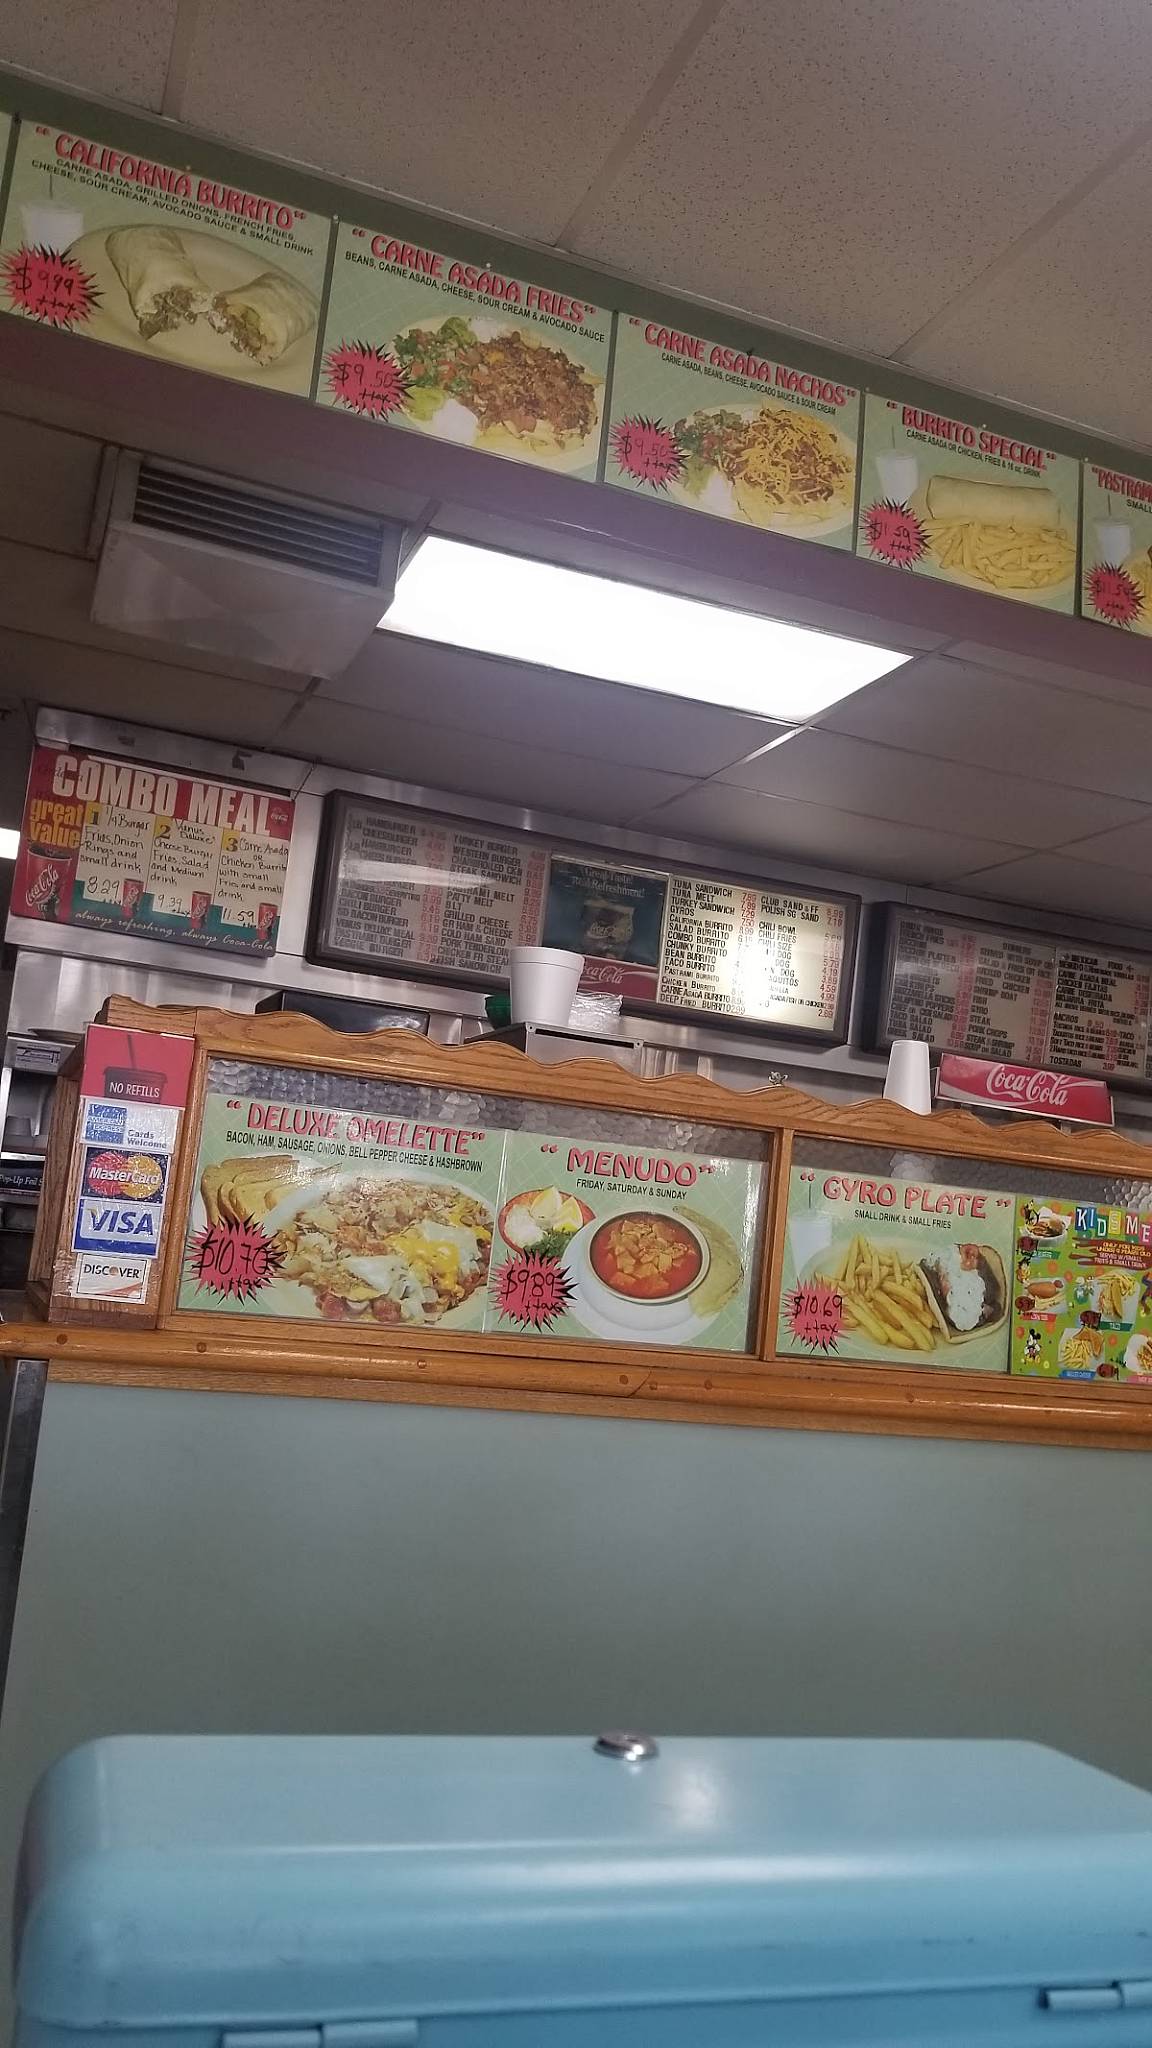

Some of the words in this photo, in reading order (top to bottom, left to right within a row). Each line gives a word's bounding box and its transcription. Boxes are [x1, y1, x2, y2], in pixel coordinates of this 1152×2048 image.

[57, 159, 91, 178] CARNE
[136, 184, 180, 204] GRILLED
[81, 174, 109, 192] SOUR
[152, 198, 202, 220] AVOCADO
[204, 215, 237, 232] SAUCE
[249, 229, 281, 247] SMALL
[284, 240, 313, 256] DRINK
[371, 234, 446, 279] CARNE
[448, 261, 521, 306] ASADA
[379, 261, 408, 278] CARNE
[478, 294, 500, 308] SOUR
[502, 303, 531, 319] CREAM
[539, 315, 577, 333] AVOCADO
[579, 327, 605, 343] SAUCE
[644, 322, 706, 364] CARNE
[709, 344, 770, 385] ASADA
[661, 352, 681, 367] CARNE
[749, 382, 775, 397] AVOCADO
[817, 403, 837, 416] CREAM
[901, 405, 976, 448] BURRITO
[928, 436, 948, 450] ASADA
[53, 754, 180, 814] COMBO
[187, 780, 272, 836] MEAL
[30, 799, 83, 827] great
[30, 820, 81, 849] value
[226, 837, 239, 852] 3
[117, 850, 138, 859] and
[151, 863, 167, 873] and
[494, 890, 515, 903] MELT
[674, 880, 692, 891] TUNA
[695, 884, 733, 898] SANDWICH
[696, 892, 715, 903] MELT
[446, 891, 470, 904] PATTY
[473, 896, 494, 908] MELT
[671, 896, 697, 909] TURKEY
[699, 902, 735, 916] SANDWICH
[760, 895, 780, 907] CLUB
[783, 899, 803, 911] SAND
[444, 908, 475, 923] GRILLED
[479, 915, 510, 929] CHEESE
[670, 905, 695, 917] GYROS
[760, 904, 785, 917] POLISH
[786, 910, 797, 919] SG
[800, 912, 820, 923] SAND
[75, 910, 113, 927] always
[181, 928, 218, 945] always
[483, 925, 512, 940] CHEESE
[669, 922, 693, 934] SALAD
[697, 927, 730, 941] BURRITO
[704, 920, 733, 932] BURRITO
[758, 921, 776, 932] CHILI
[441, 928, 461, 938] COLD
[463, 931, 482, 943] HAM
[485, 935, 506, 948] SAND
[441, 936, 461, 948] PORK
[667, 931, 693, 943] COMBO
[696, 936, 726, 949] BURRITO
[777, 934, 797, 945] FRIES
[777, 941, 792, 952] SIZE
[665, 949, 685, 960] BEAN
[686, 952, 717, 964] BURRITO
[666, 939, 694, 951] CHUNKY
[696, 945, 728, 958] BURRITO
[777, 951, 792, 961] DOG
[665, 957, 685, 968] TACO
[686, 961, 715, 973] BURRITO
[780, 969, 795, 979] DOG
[1049, 1055, 1083, 1068] TOSTADAS
[109, 1081, 124, 1094] NO
[126, 1083, 160, 1099] REFILLS
[986, 1063, 1068, 1107] Coca-Cola
[247, 1102, 341, 1140] DELUXE
[127, 1137, 167, 1149] Welcome
[128, 1129, 155, 1140] Cards
[226, 1130, 256, 1147] BACON,
[256, 1134, 275, 1149] HAM,
[277, 1136, 316, 1155] SAUSAGE,
[348, 1145, 368, 1161] BELL
[369, 1147, 399, 1164] PEPPER
[399, 1151, 429, 1167] CHEESE
[435, 1156, 483, 1176] HASHBROWN
[88, 1166, 161, 1185] MasterCard
[576, 1178, 606, 1194] FRIDAY,
[607, 1182, 648, 1196] SATURDAY
[656, 1187, 687, 1200] SUNDAY
[823, 1176, 896, 1208] GYRO
[904, 1186, 988, 1220] PLATE
[87, 1207, 155, 1236] VISA
[854, 1209, 878, 1221] SMALL
[879, 1211, 901, 1223] DRINK
[908, 1215, 931, 1227] SMALL
[932, 1218, 952, 1230] FRIES
[1076, 1207, 1121, 1237] KIDS
[83, 1263, 140, 1279] DISCOVER
